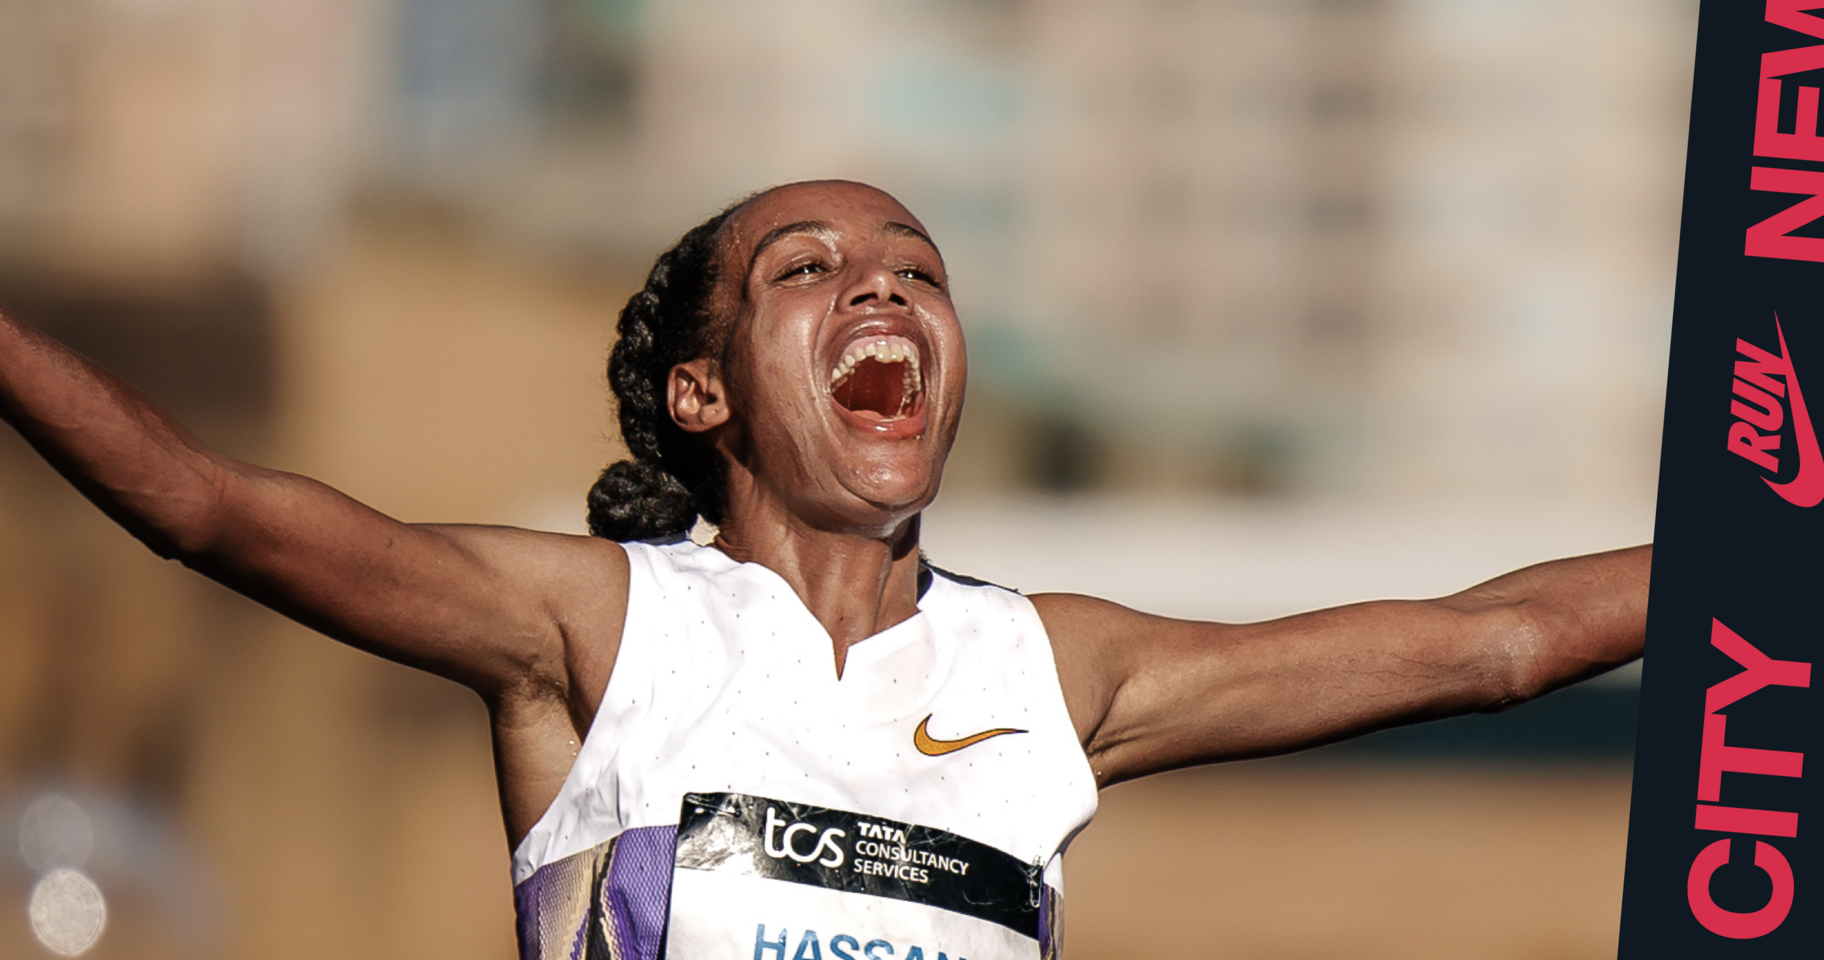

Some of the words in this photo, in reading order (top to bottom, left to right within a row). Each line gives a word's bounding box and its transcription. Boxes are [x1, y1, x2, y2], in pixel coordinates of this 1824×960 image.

[764, 807, 846, 868] tcs
[857, 821, 906, 844] TATA
[853, 858, 929, 884] SERVICES
[855, 840, 970, 876] CONSULTANCY
